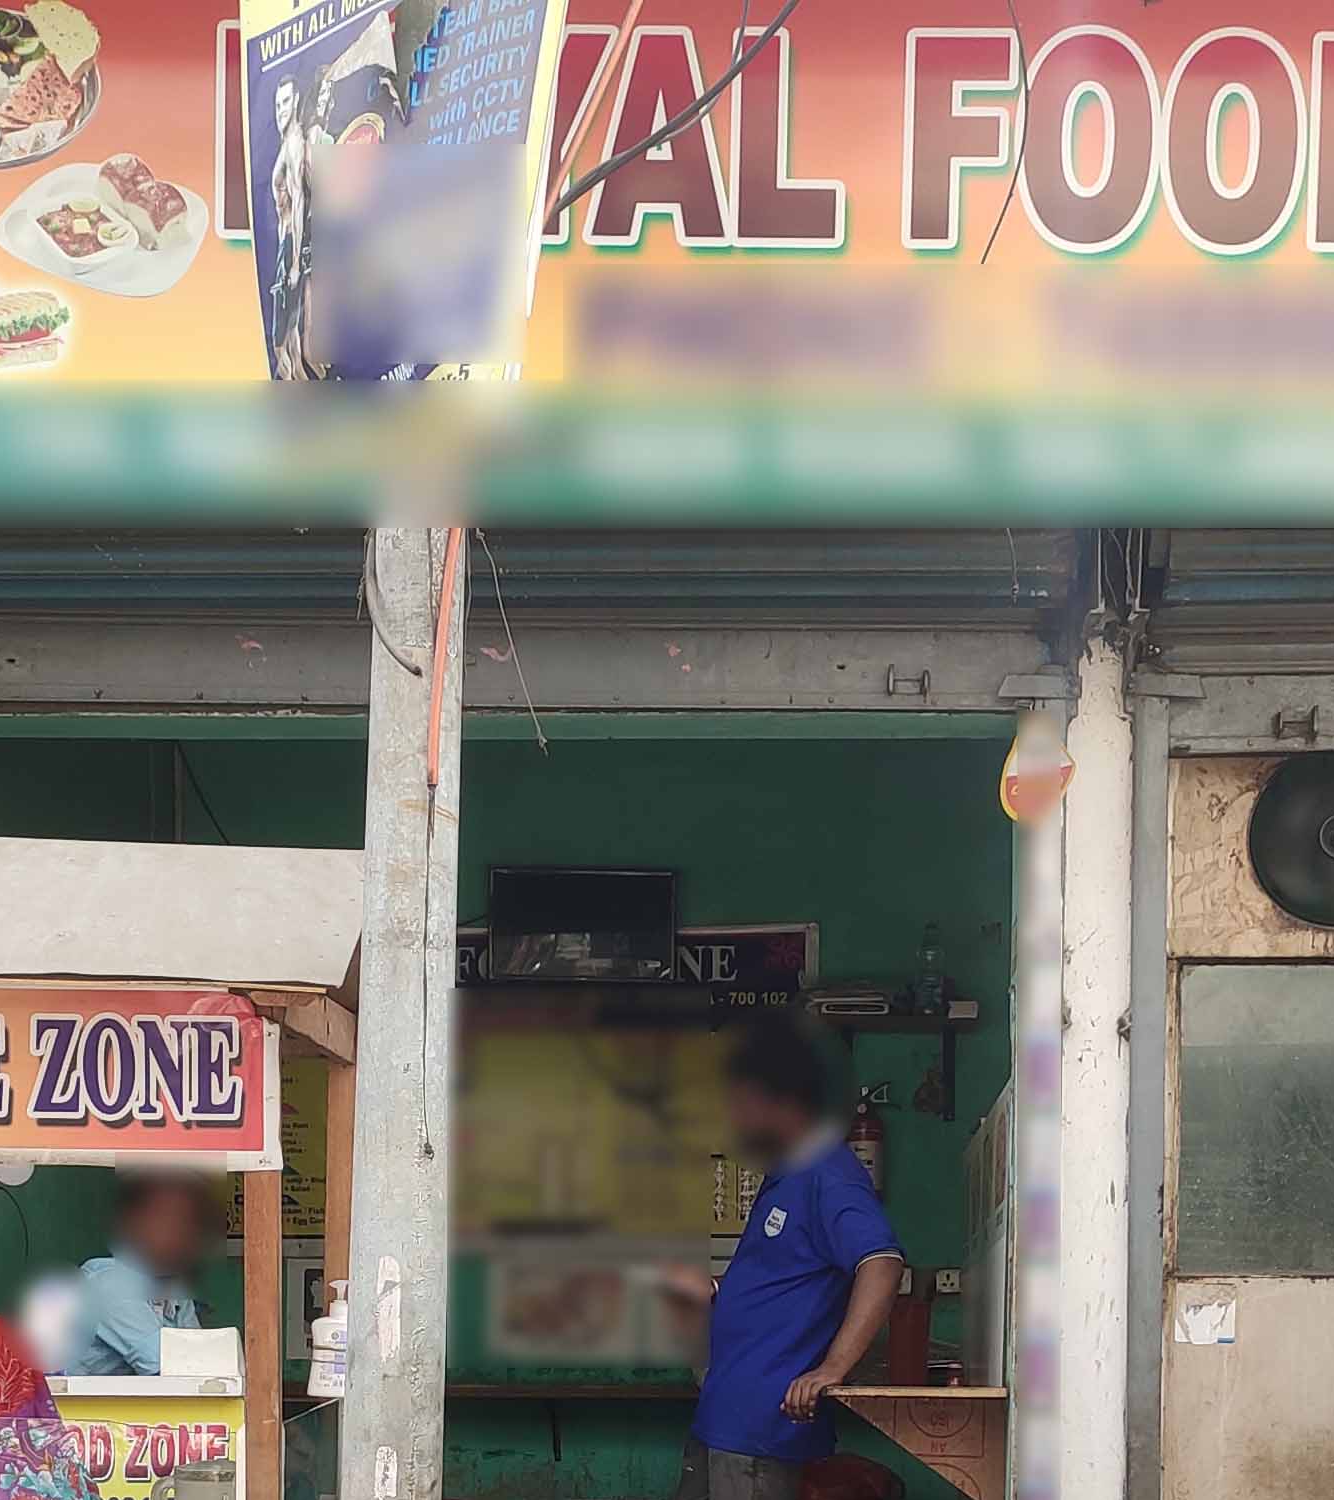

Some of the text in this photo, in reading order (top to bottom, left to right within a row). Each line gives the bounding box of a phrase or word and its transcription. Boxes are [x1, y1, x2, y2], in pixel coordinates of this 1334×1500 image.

[260, 19, 304, 62] WITH
[308, 3, 336, 38] ALL
[458, 8, 536, 60] TRAINER
[437, 42, 532, 98] SECURITY
[429, 76, 526, 130] with CCTV
[676, 945, 738, 983] NE
[730, 992, 789, 1005] 700 102
[32, 1016, 239, 1118] ZONE
